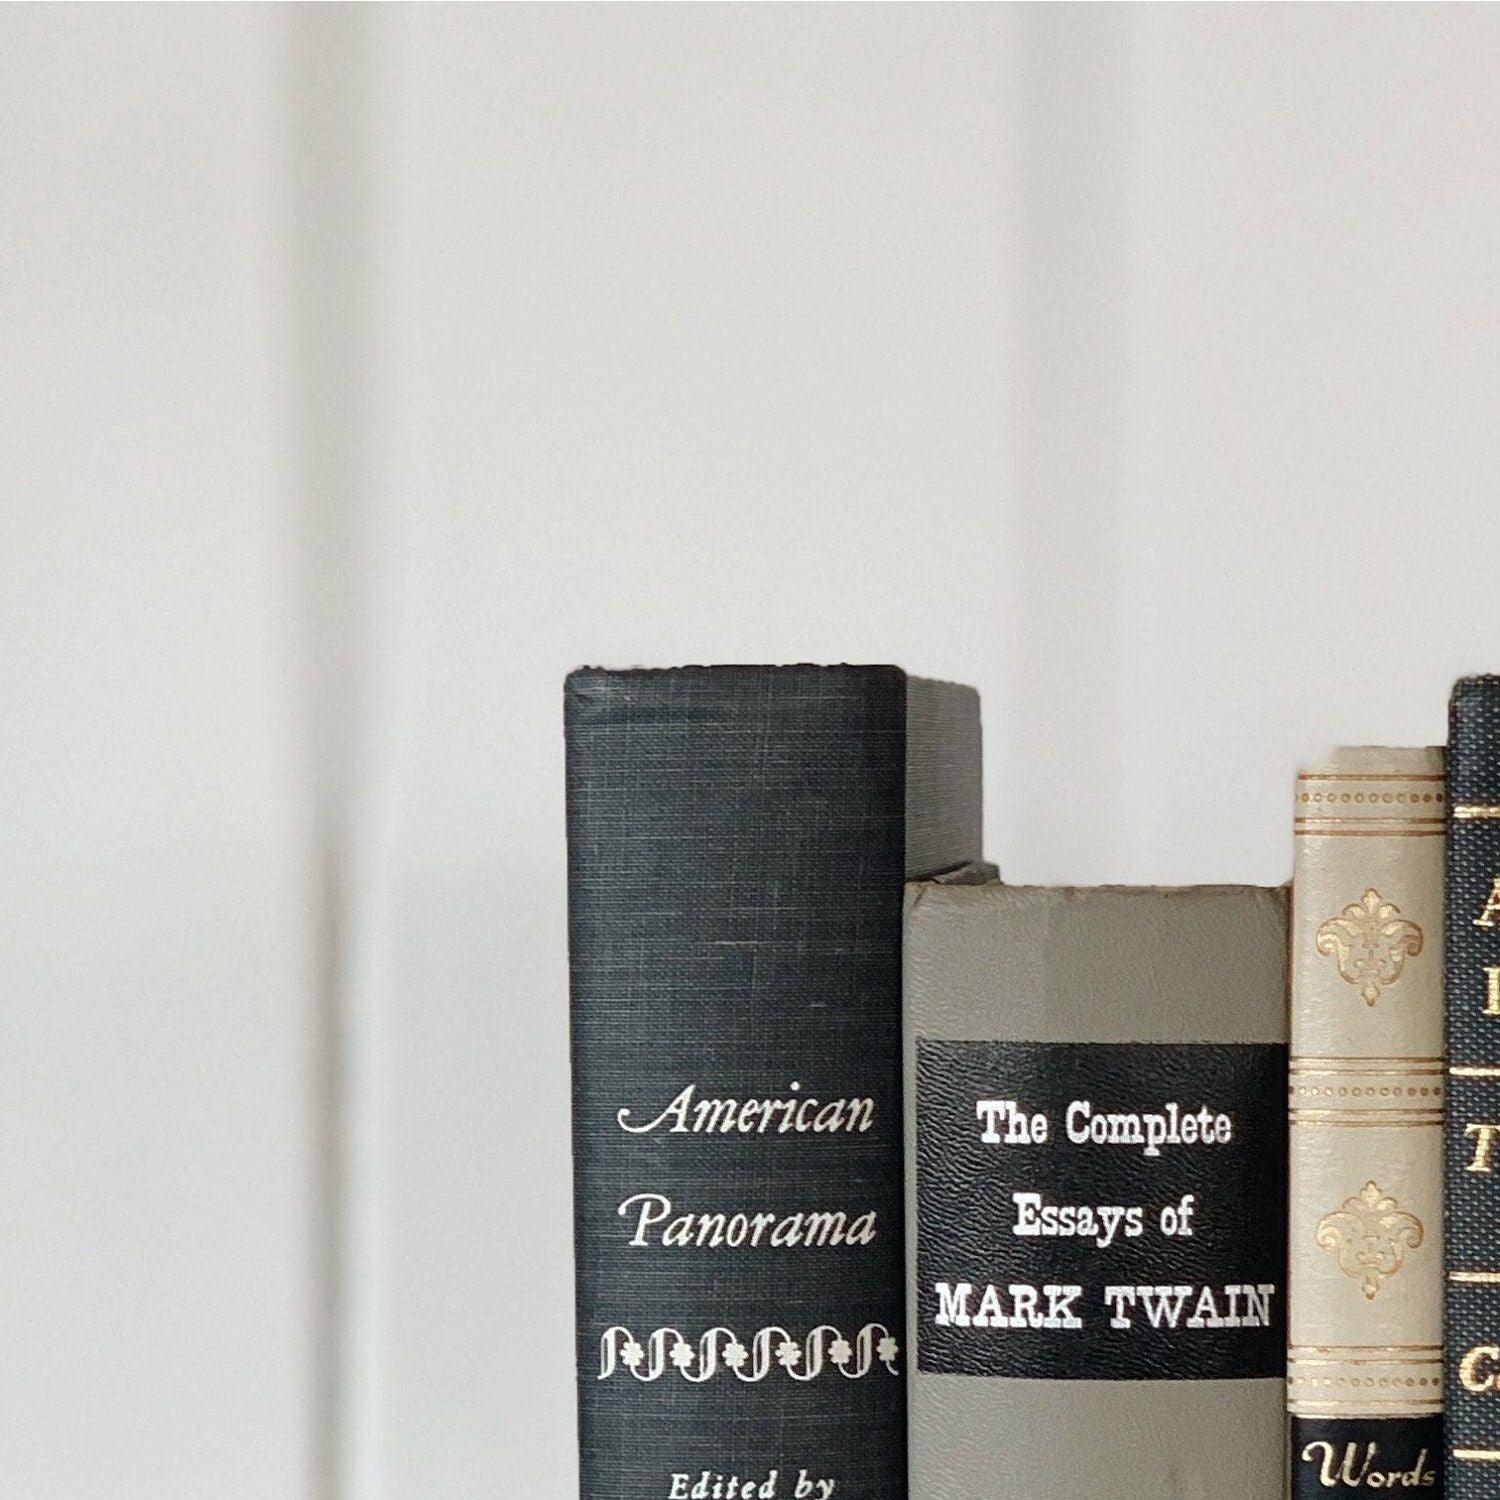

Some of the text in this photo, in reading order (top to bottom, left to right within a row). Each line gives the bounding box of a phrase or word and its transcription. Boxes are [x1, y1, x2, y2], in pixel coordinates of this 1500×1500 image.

[617, 1081, 874, 1134] American
[976, 1100, 1232, 1155] The Complete
[617, 1194, 876, 1247] Panorama
[1012, 1193, 1194, 1247] Essays of
[934, 1282, 1275, 1327] MARK TWAIN
[668, 1471, 776, 1500] Edited
[1302, 1441, 1436, 1488] Words
